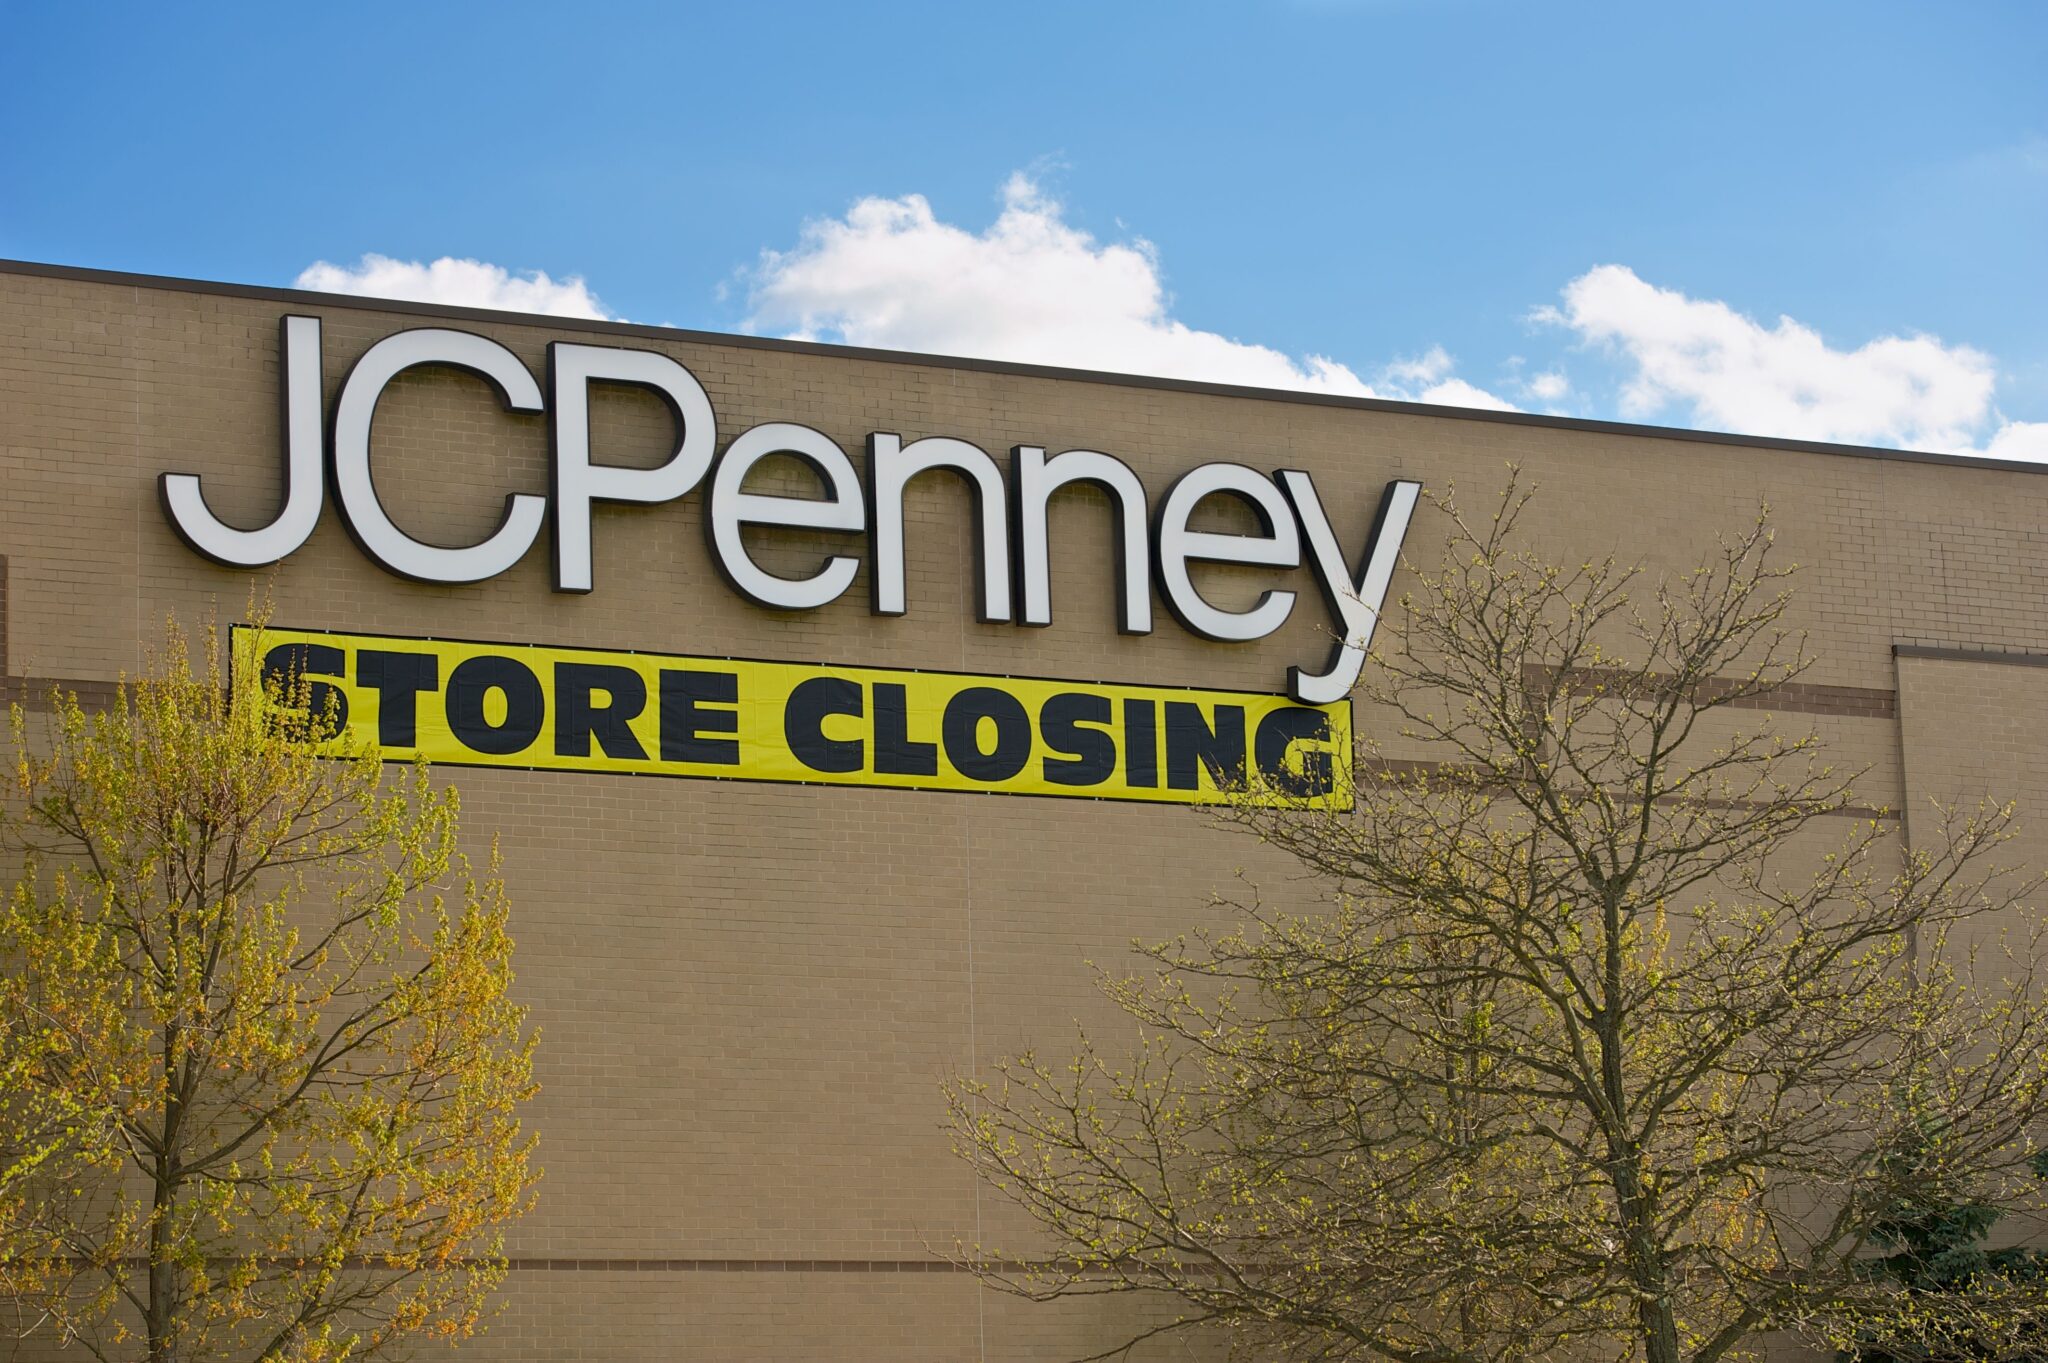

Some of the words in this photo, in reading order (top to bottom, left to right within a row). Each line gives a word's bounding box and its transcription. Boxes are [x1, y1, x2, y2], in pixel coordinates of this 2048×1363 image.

[159, 314, 1423, 704] JCPenney
[260, 643, 740, 766] STORE
[784, 676, 1334, 798] CLOSING
